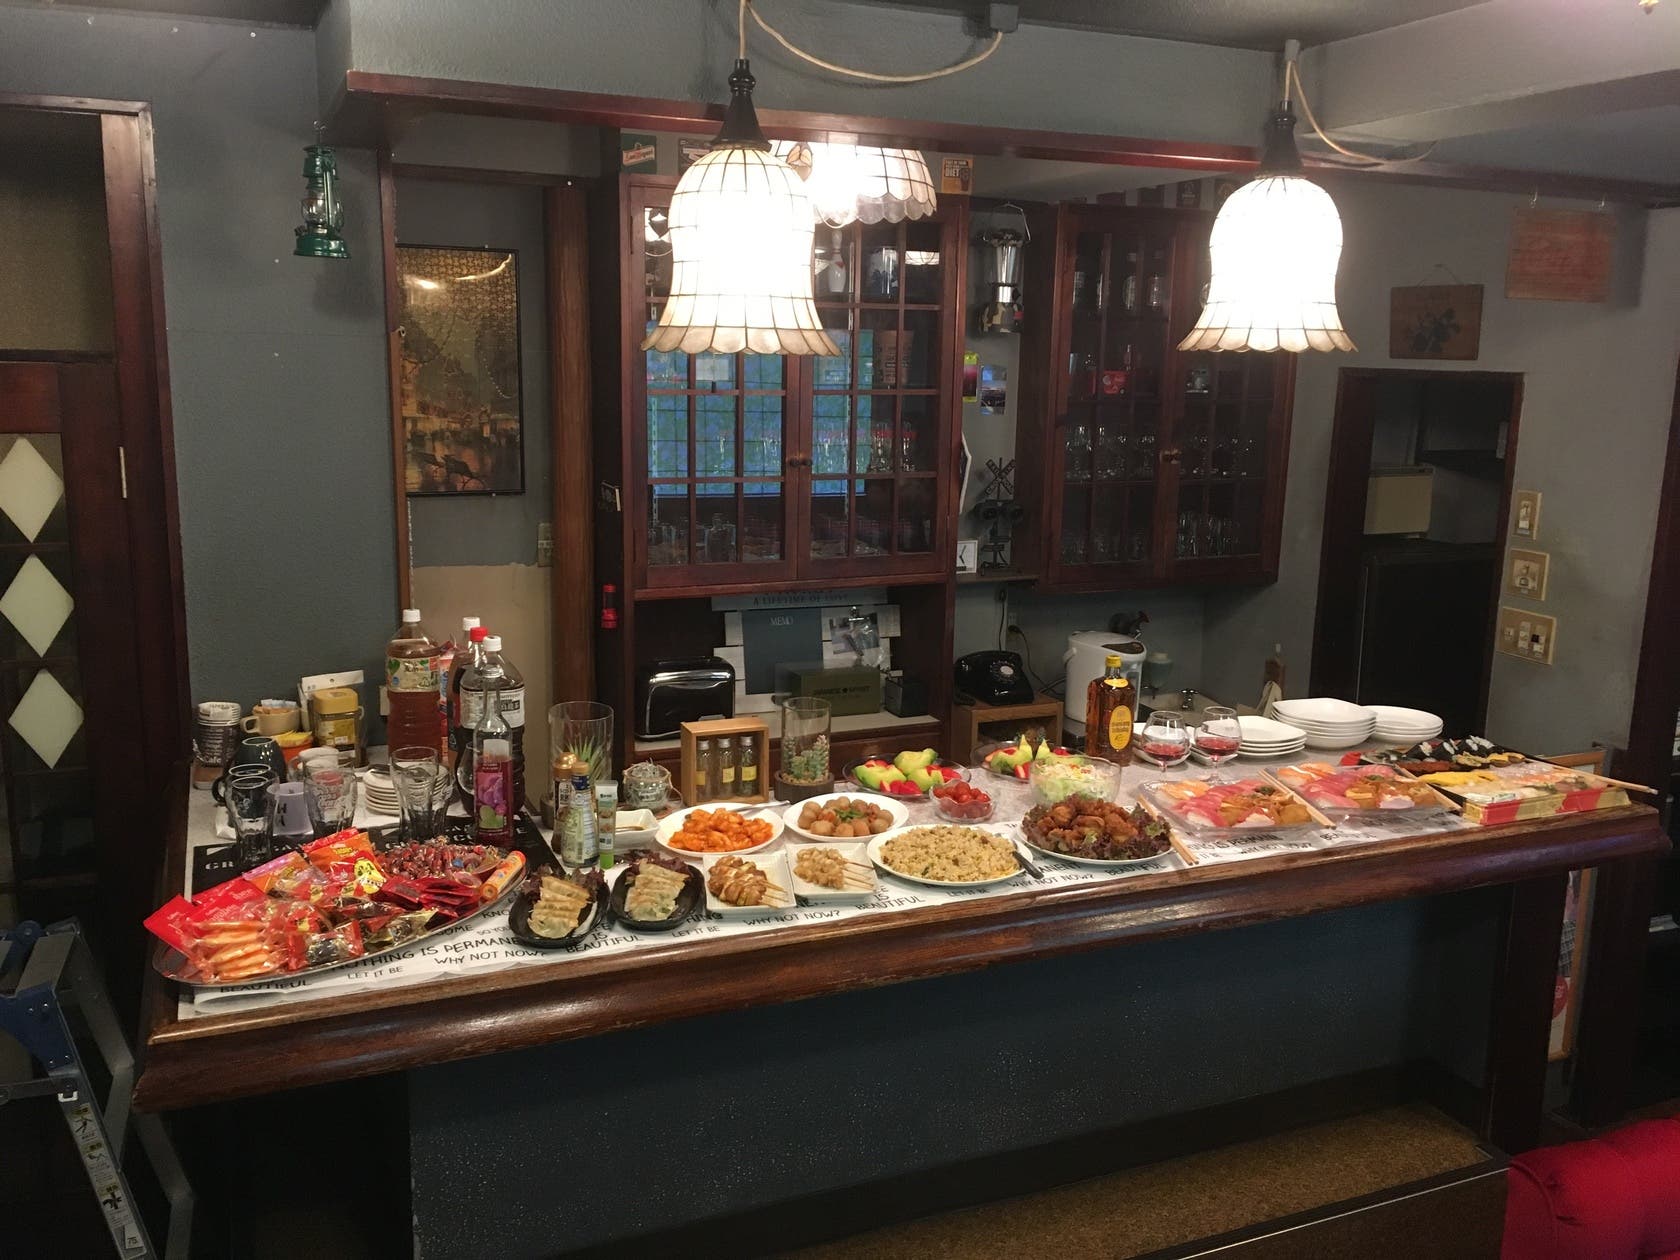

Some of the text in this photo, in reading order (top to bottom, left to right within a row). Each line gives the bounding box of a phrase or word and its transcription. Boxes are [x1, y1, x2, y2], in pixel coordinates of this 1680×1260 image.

[1035, 875, 1060, 886] NOT
[855, 895, 925, 911] BEAUTIFUL
[772, 913, 799, 923] NOT
[804, 909, 841, 919] NOW?
[592, 932, 608, 941] IS
[567, 934, 644, 954] BEAUTIFUL
[420, 945, 439, 957] IS
[434, 955, 465, 965] WHY
[469, 950, 499, 962] NOT
[388, 965, 404, 975] BE
